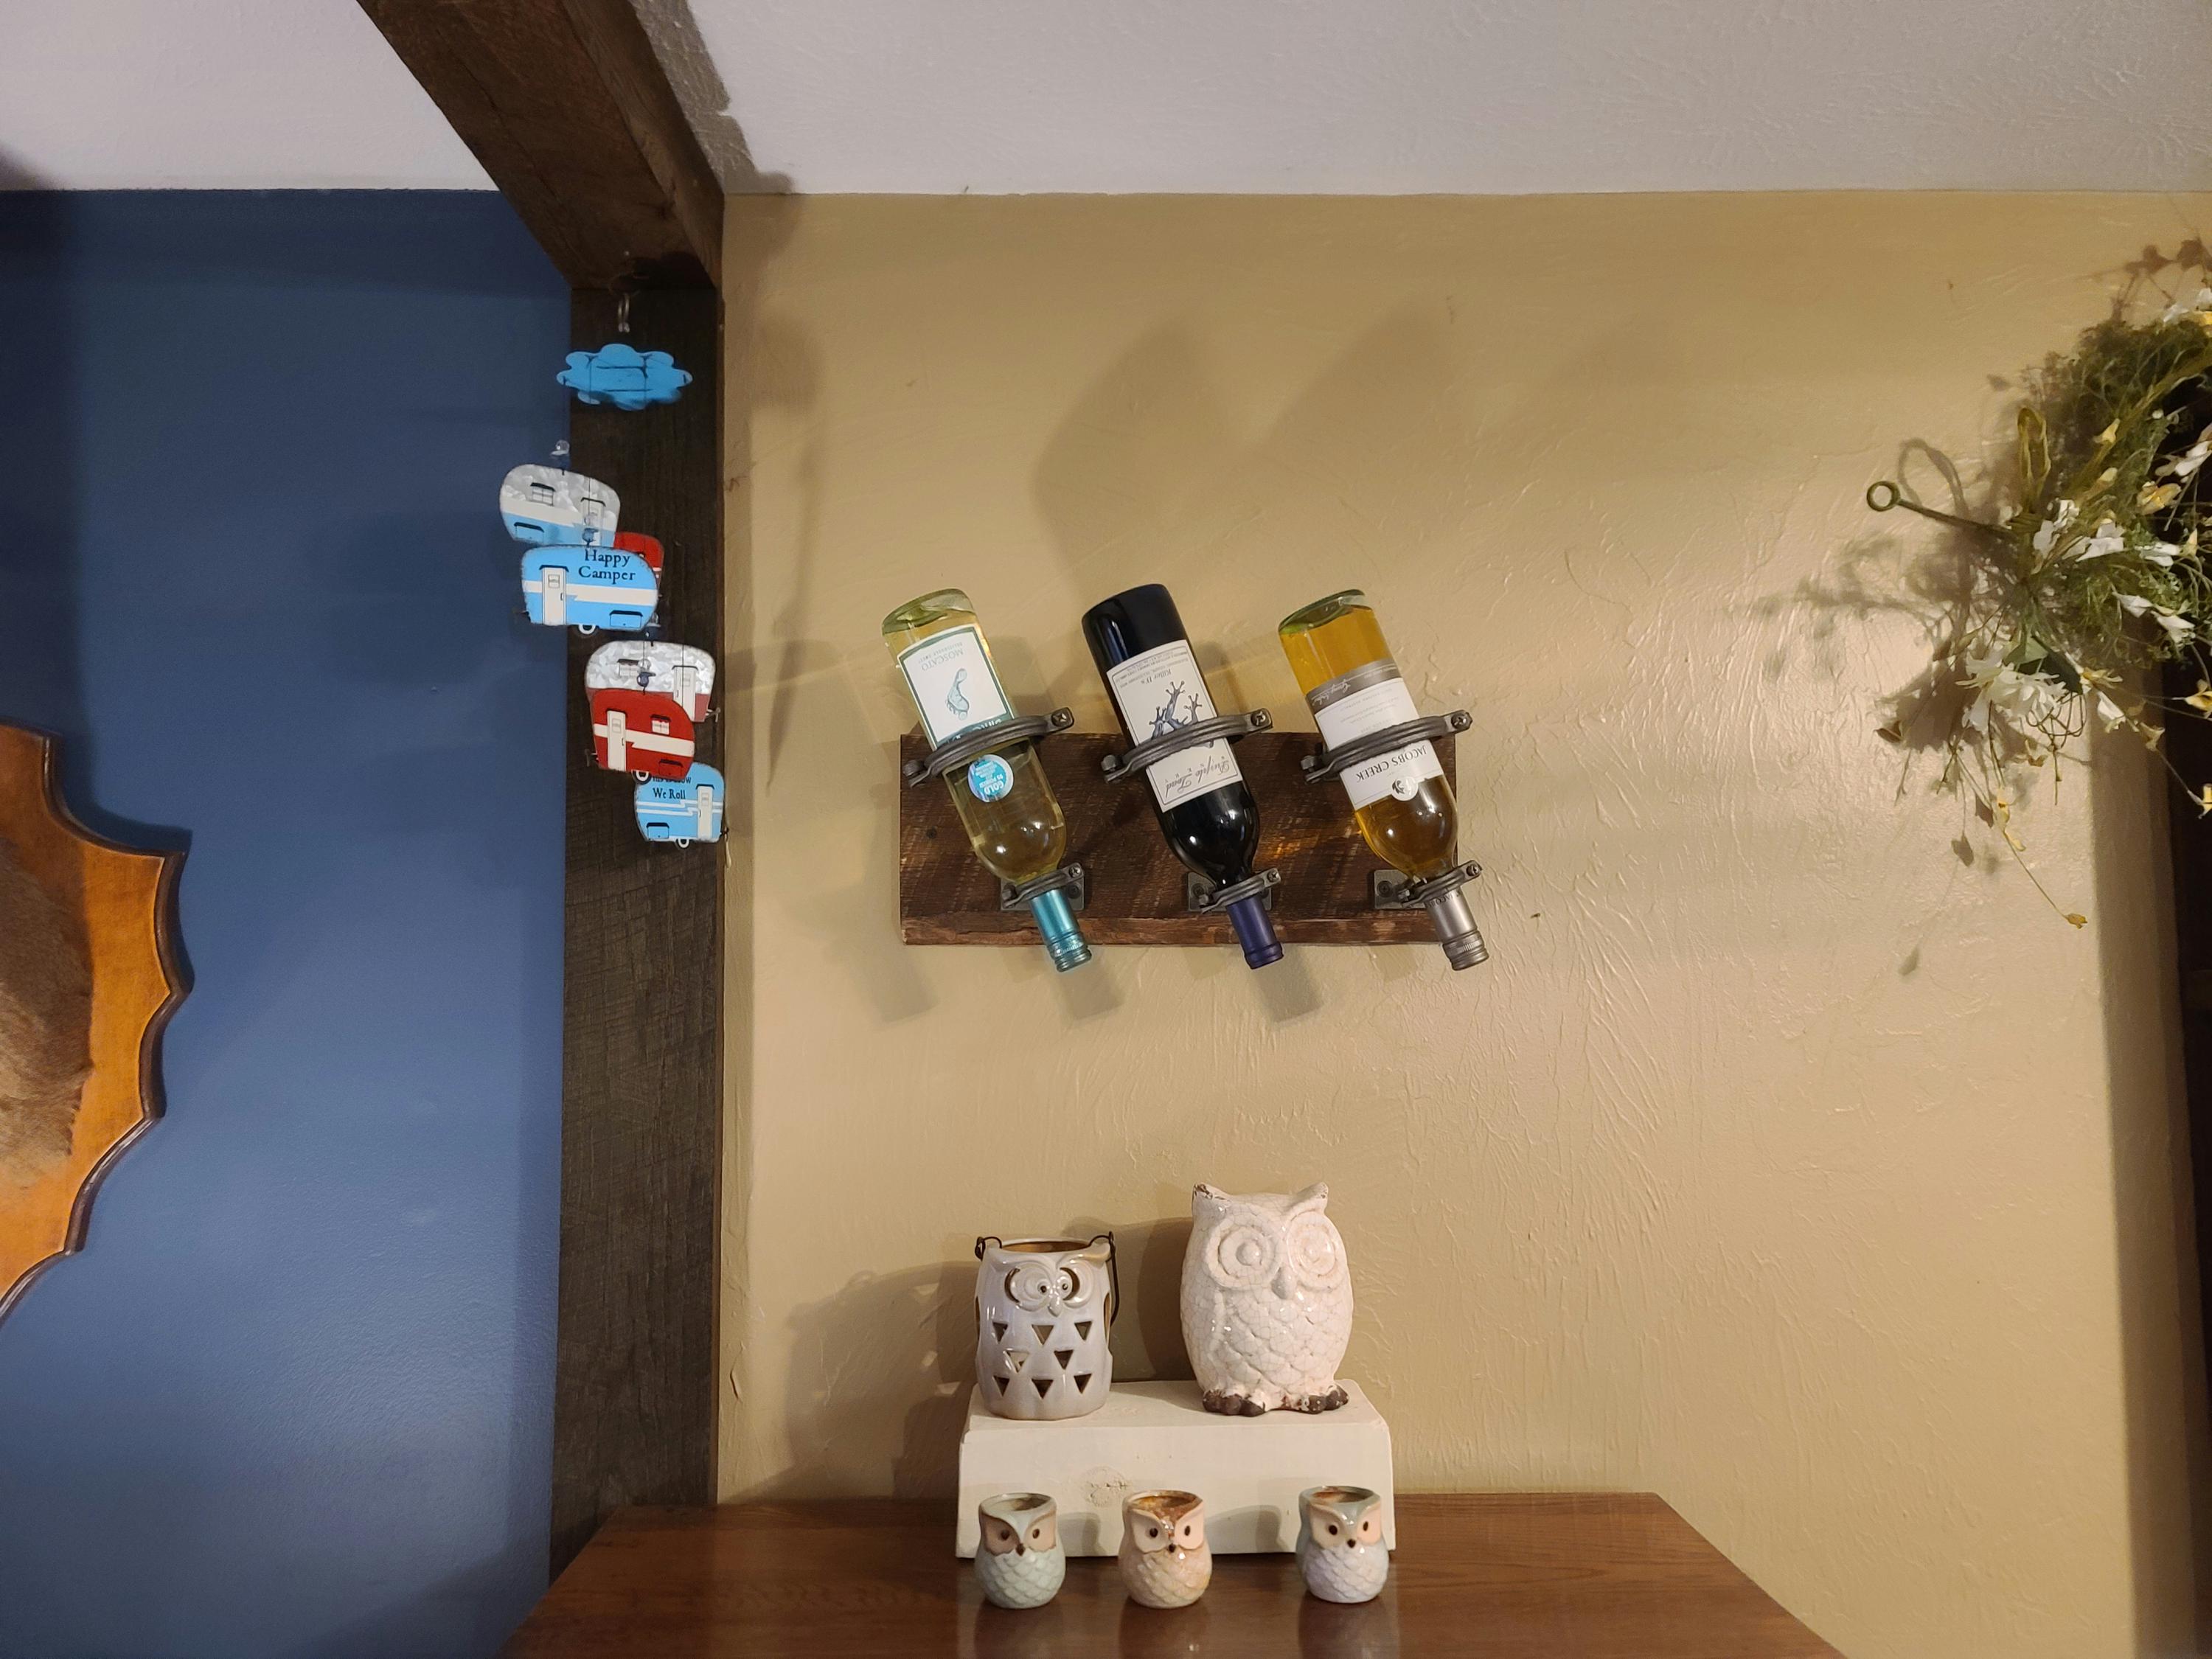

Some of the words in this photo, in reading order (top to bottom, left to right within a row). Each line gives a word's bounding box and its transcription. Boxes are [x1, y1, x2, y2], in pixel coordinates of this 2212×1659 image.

[585, 549, 630, 567] Happy
[579, 566, 636, 584] Camper
[920, 648, 963, 670] MOSCATO
[1153, 668, 1171, 678] Killer
[1391, 745, 1426, 767] JACOB'S
[1195, 755, 1229, 784] Purple
[1356, 761, 1388, 782] CREEK
[653, 787, 667, 799] We
[669, 789, 686, 799] Roll
[983, 780, 1004, 795] GOLD
[1165, 773, 1192, 798] Toad
